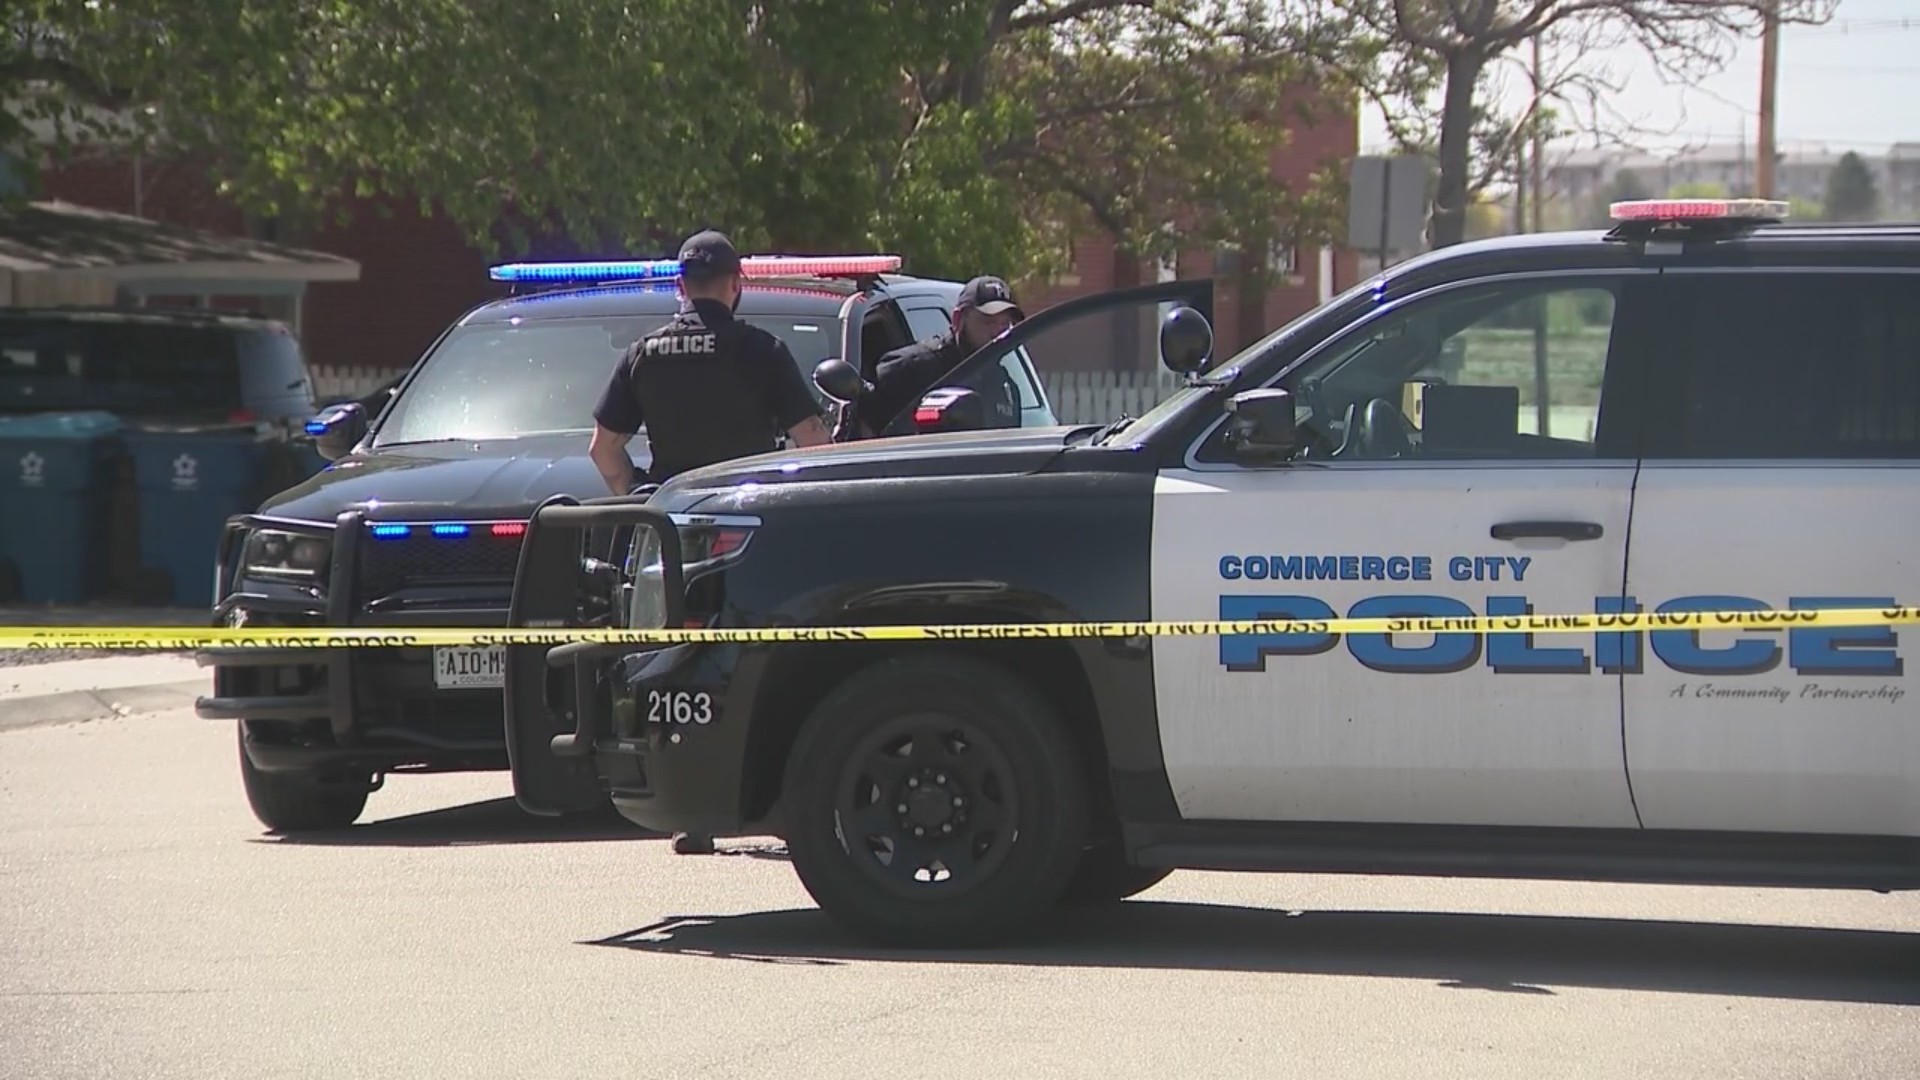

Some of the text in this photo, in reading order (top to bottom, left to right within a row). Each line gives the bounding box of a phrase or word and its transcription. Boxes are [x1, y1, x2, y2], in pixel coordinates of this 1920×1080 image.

[646, 334, 716, 356] POLICE
[1219, 556, 1531, 581] COMMERCE CITY
[1219, 595, 1903, 675] POLICE
[1669, 683, 1905, 704] A Community Partnership
[648, 690, 712, 724] 2163
